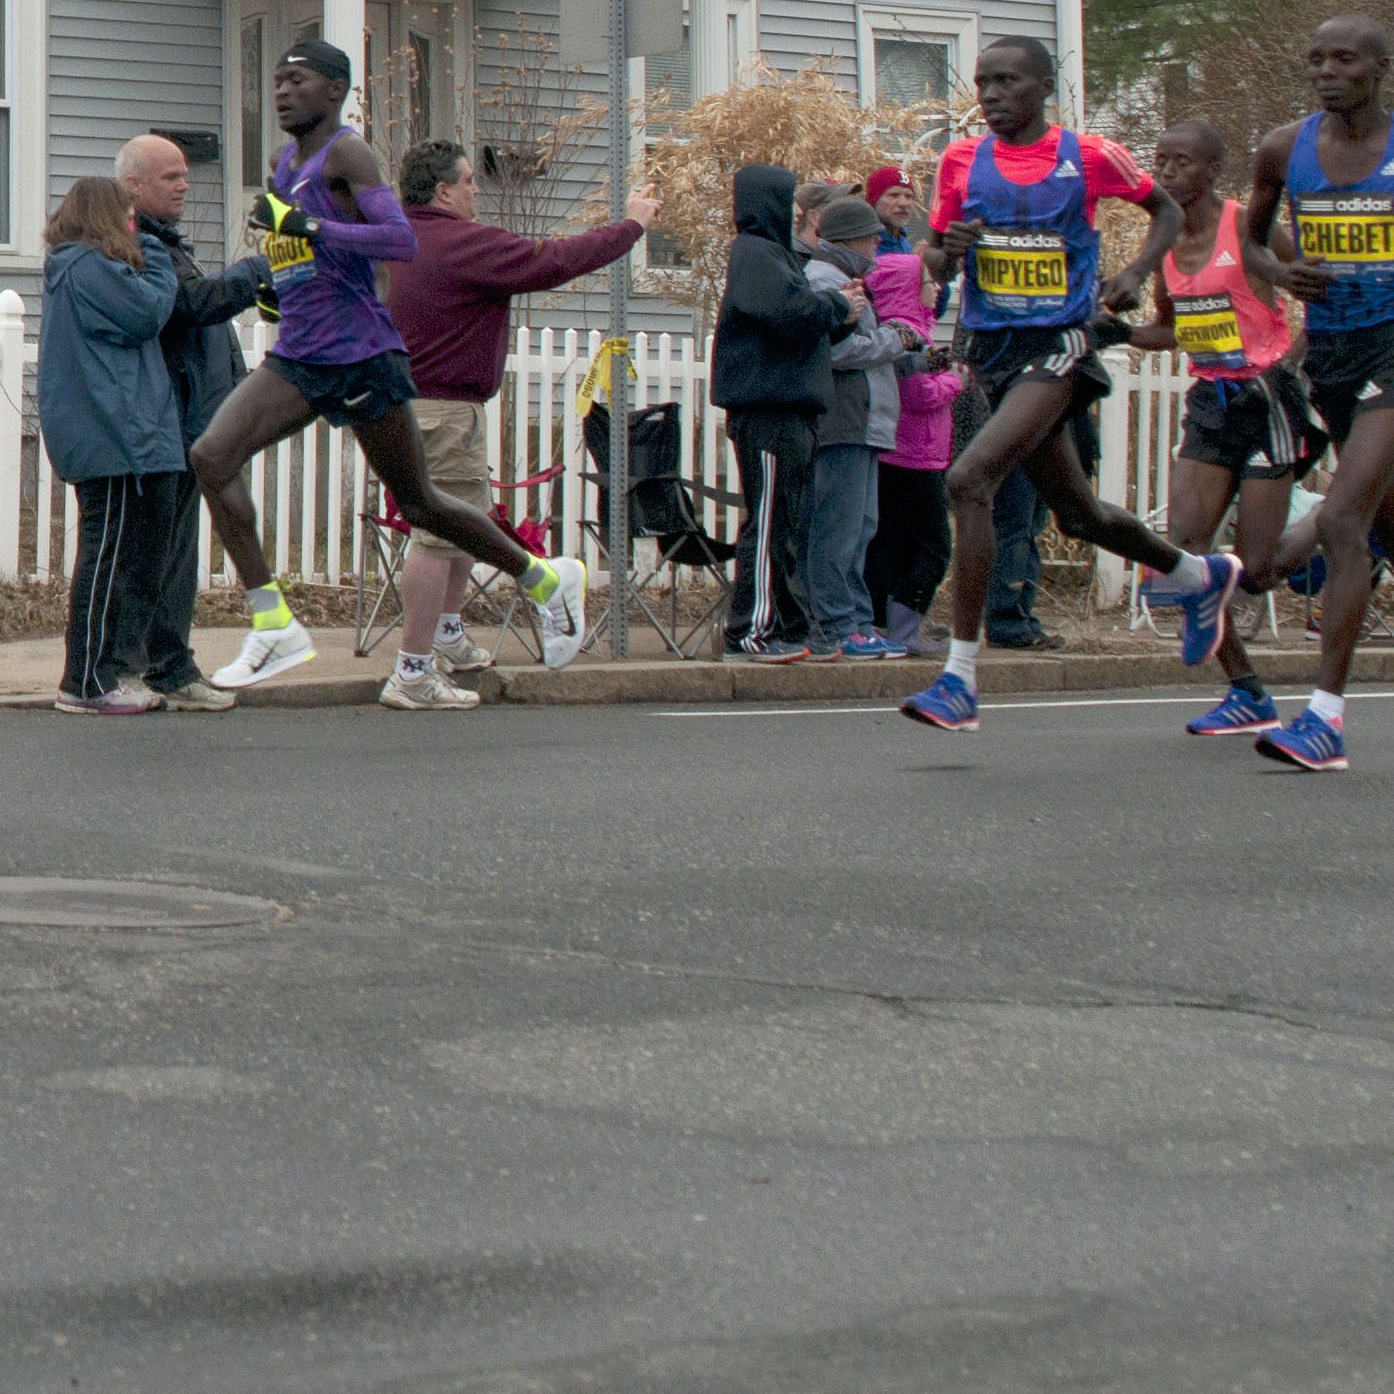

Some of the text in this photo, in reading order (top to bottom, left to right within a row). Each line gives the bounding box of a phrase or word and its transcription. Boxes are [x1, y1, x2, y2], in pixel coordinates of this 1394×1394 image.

[898, 170, 910, 185] B
[1335, 198, 1392, 212] adidas
[1009, 234, 1061, 248] adidas
[1301, 221, 1394, 254] CHEBET
[1191, 298, 1231, 312] adidas
